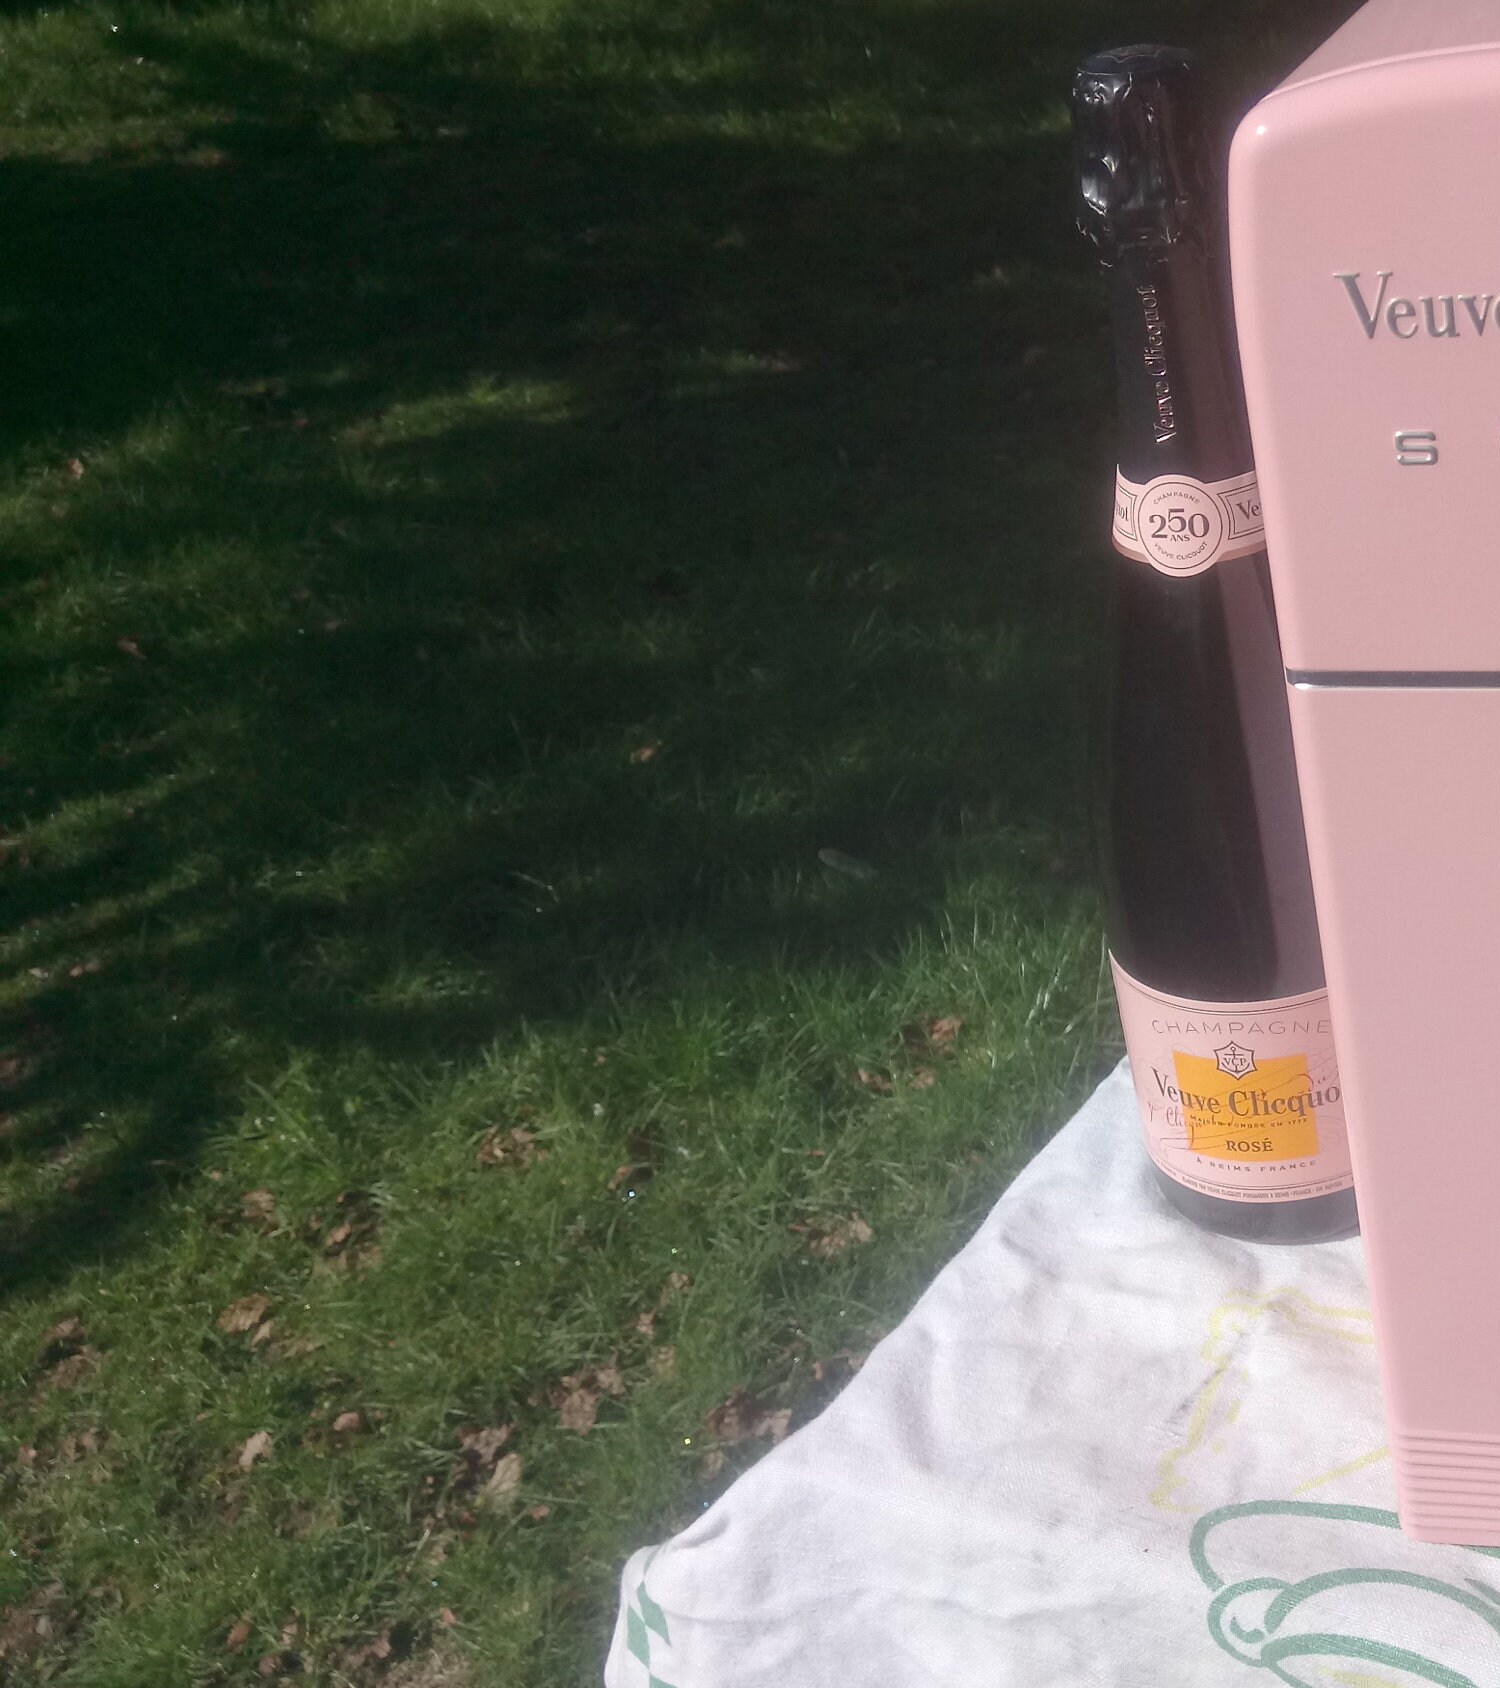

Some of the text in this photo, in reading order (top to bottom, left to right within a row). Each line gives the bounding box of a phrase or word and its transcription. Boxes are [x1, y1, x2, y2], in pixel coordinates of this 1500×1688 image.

[1154, 381, 1177, 444] Veuve
[1153, 491, 1200, 505] CHAMPAGNE
[1235, 499, 1261, 520] Ve
[1148, 508, 1210, 538] 250
[1169, 534, 1191, 542] ANS
[1175, 541, 1208, 560] CLICQUOT
[1152, 1019, 1330, 1035] CHAMPAGNE
[1150, 1066, 1221, 1114] Veuve
[1228, 1086, 1341, 1117] Clicquo
[1226, 1138, 1273, 1153] ROSÉ
[1209, 1161, 1251, 1172] REIMS
[1259, 1160, 1317, 1172] FRANCE
